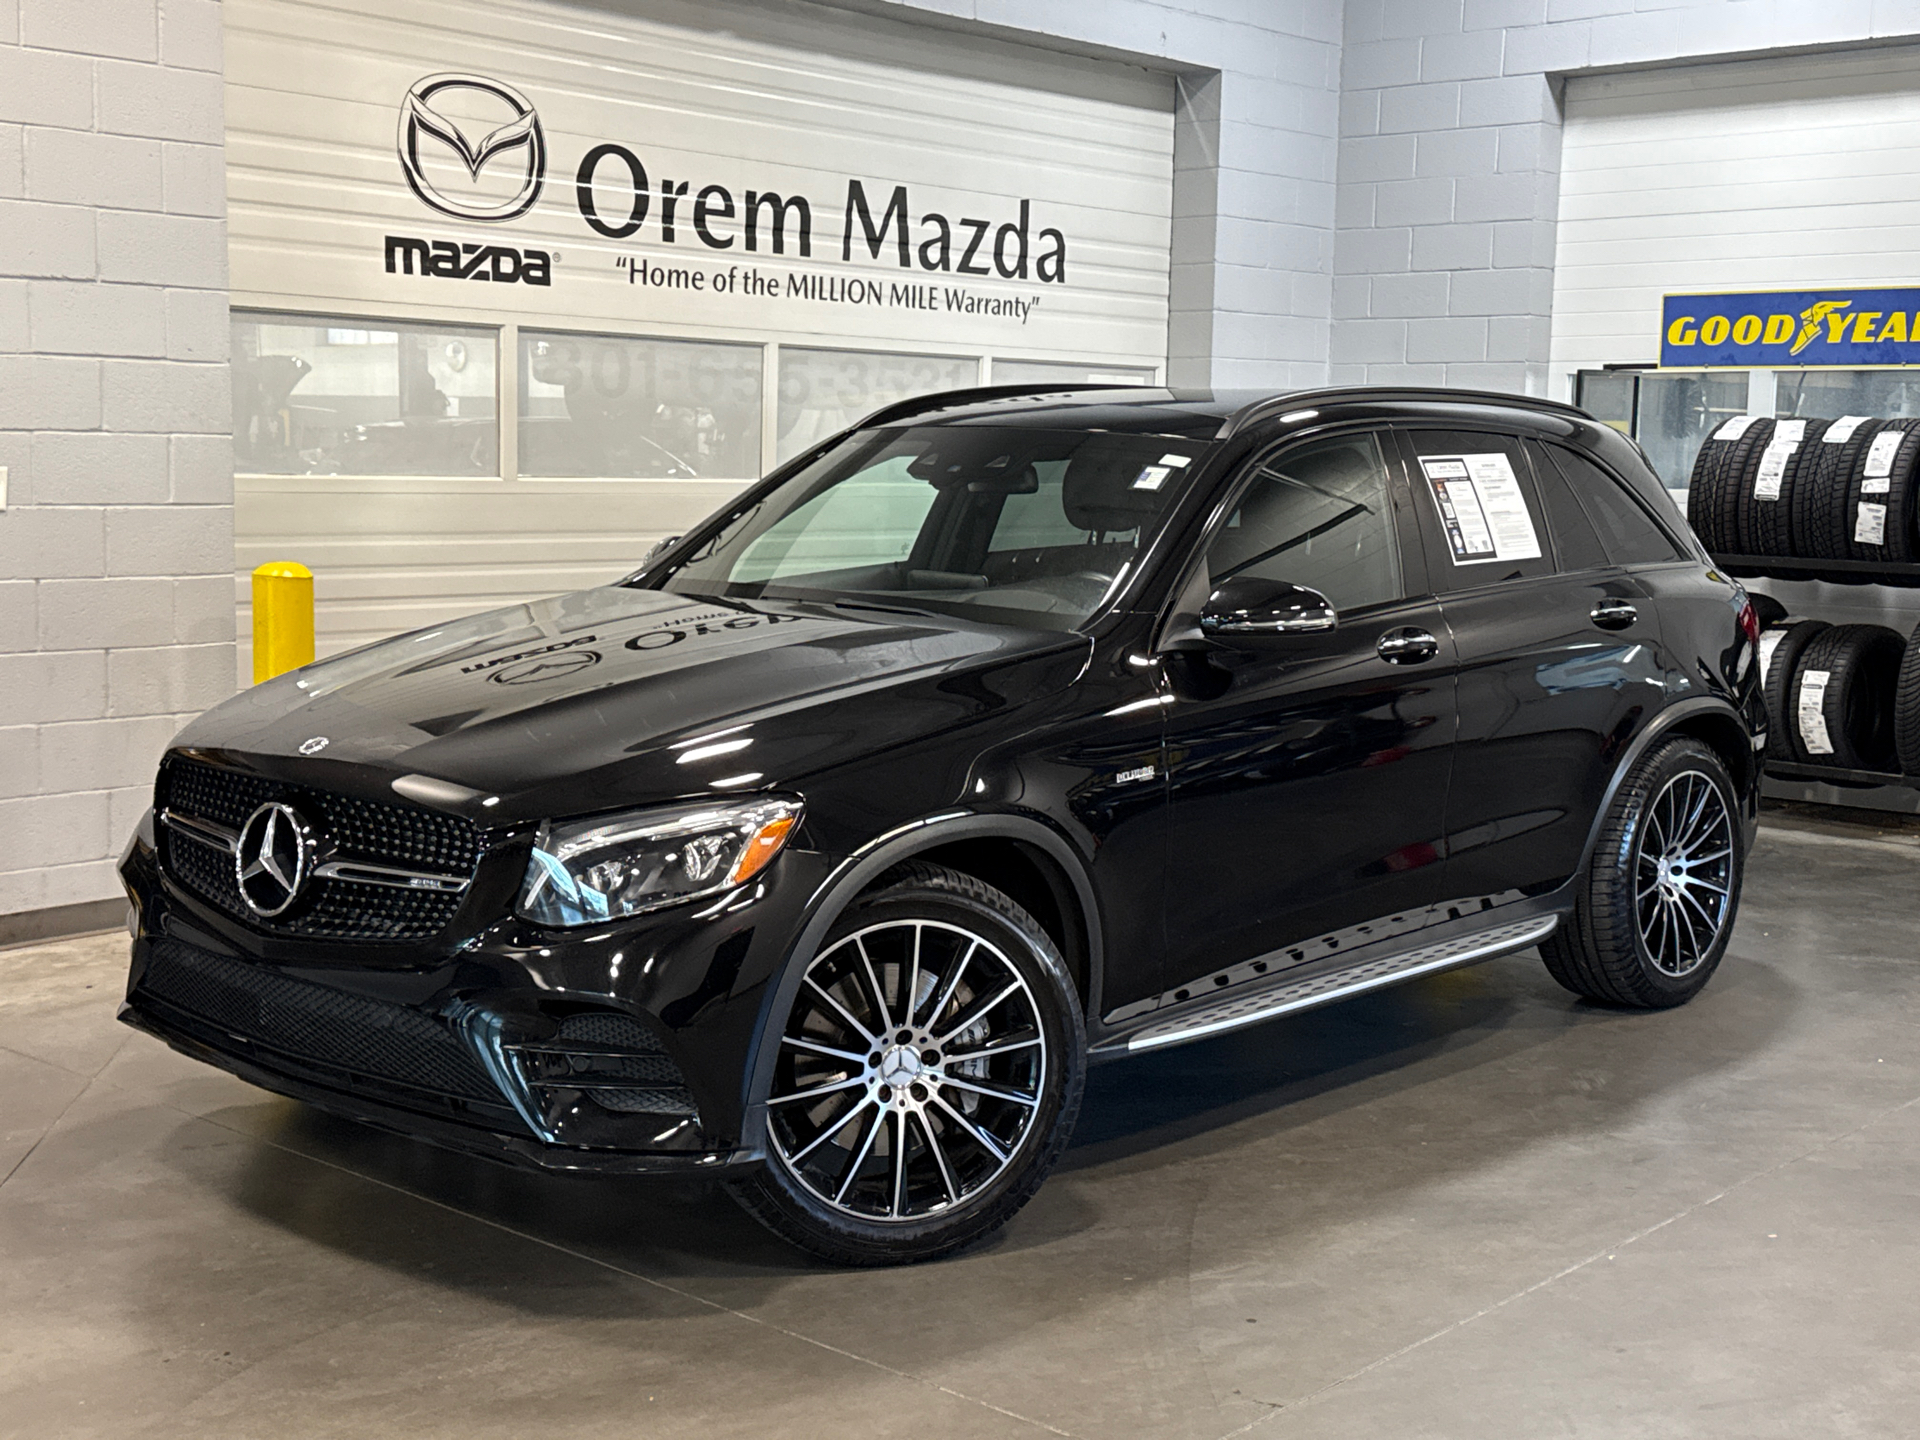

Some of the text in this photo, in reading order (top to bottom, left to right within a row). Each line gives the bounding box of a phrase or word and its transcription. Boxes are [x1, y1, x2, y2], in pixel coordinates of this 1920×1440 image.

[576, 143, 1066, 283] Orem Mazda
[712, 266, 738, 293] of
[743, 268, 780, 296] the
[786, 273, 883, 306] MILLION
[889, 283, 938, 311] MILE
